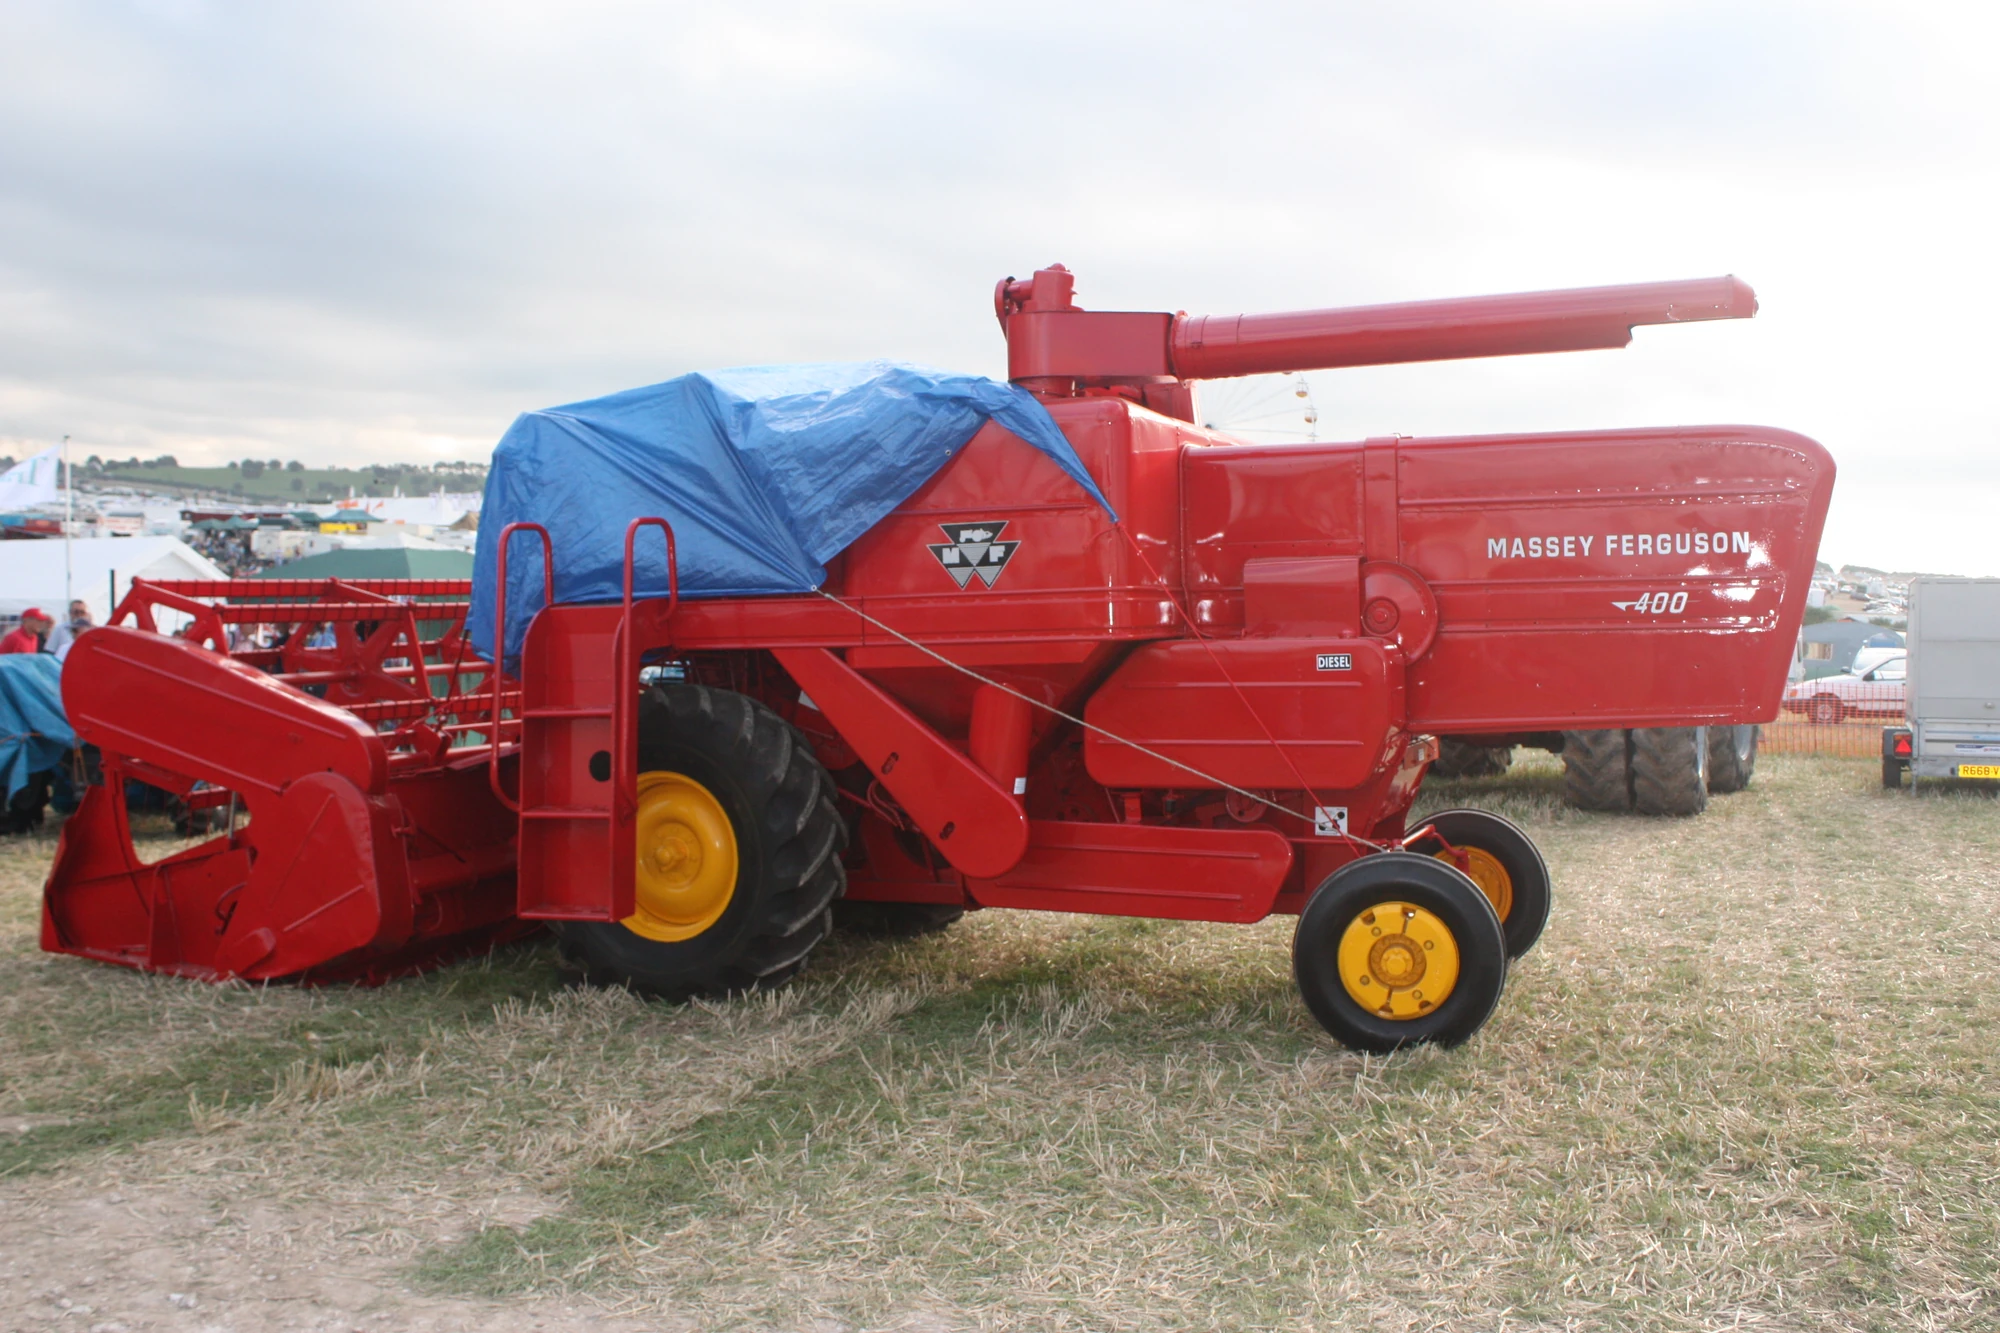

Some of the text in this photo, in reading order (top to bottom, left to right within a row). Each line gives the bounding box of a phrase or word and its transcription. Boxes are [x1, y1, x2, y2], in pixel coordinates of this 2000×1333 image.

[1487, 531, 1750, 559] MASSEY FERGUSON
[1633, 592, 1689, 614] 400
[1318, 656, 1350, 668] DIESEL
[1963, 766, 1990, 776] R668
